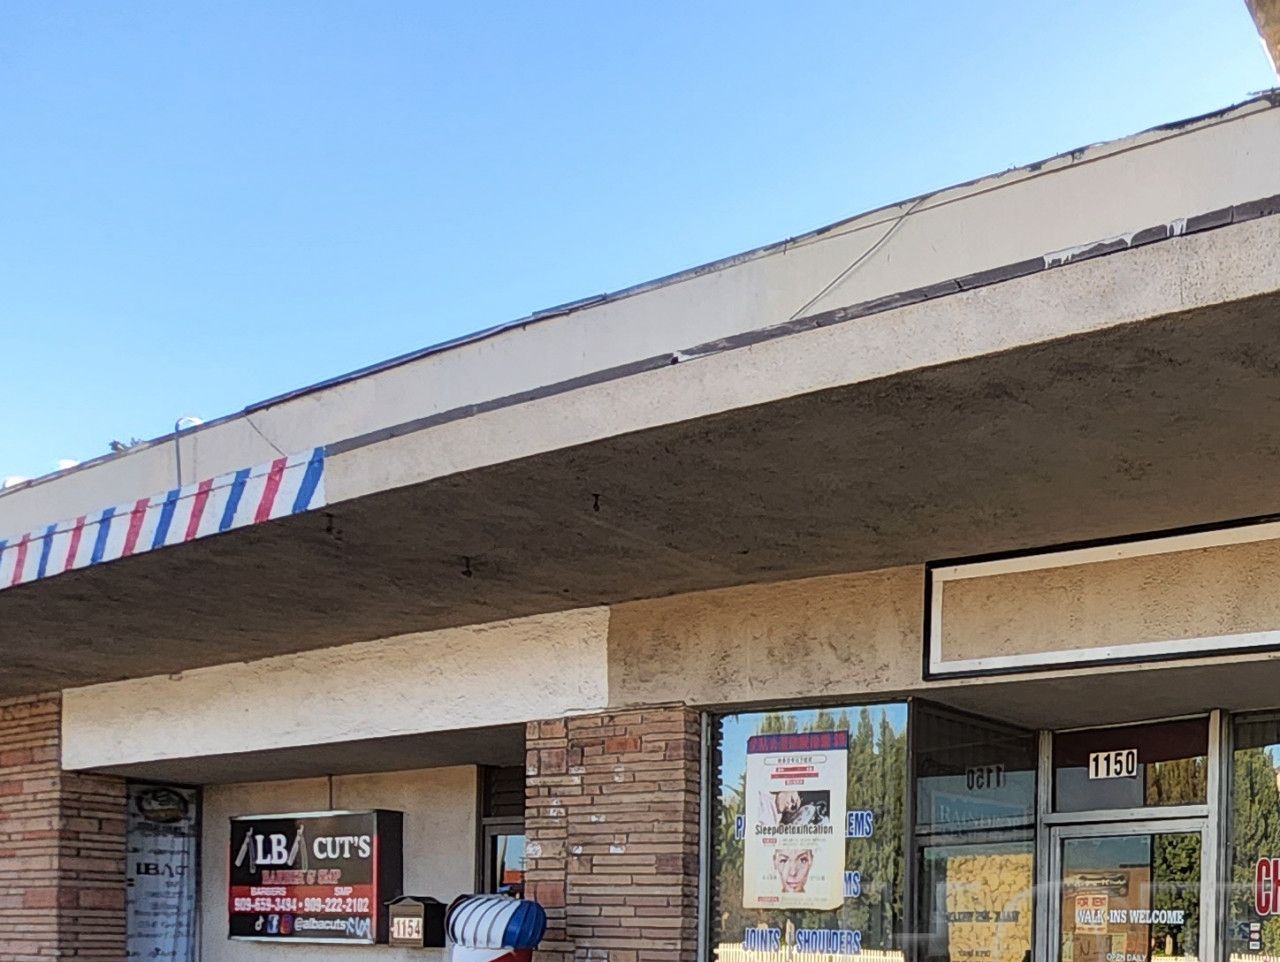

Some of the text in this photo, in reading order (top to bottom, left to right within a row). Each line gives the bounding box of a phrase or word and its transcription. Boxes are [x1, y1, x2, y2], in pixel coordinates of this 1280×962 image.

[1092, 751, 1136, 777] 1150
[313, 835, 371, 859] CUT'S
[334, 886, 353, 896] SMP
[1129, 910, 1184, 924] WELCOME
[396, 919, 420, 937] 1154
[742, 928, 780, 951] JOINTS
[795, 929, 861, 955] SHOULDERS
[1127, 954, 1147, 962] DAILY
